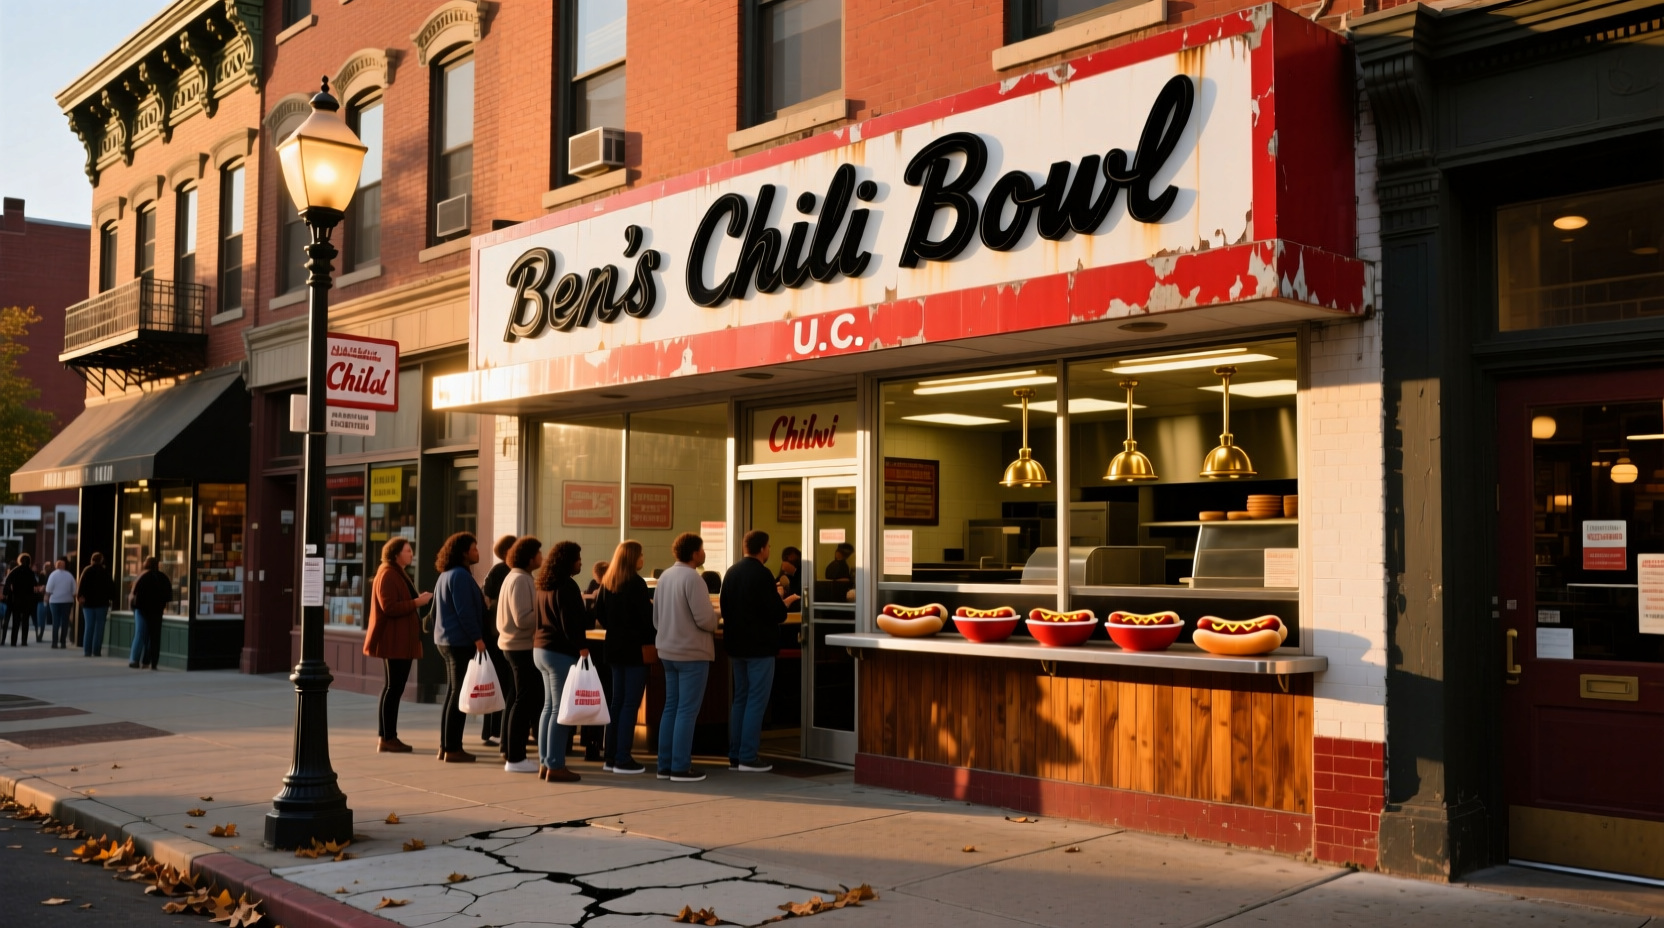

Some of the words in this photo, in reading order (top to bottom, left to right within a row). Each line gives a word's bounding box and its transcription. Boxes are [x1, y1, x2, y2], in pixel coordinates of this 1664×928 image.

[504, 225, 661, 343] Ben's
[686, 163, 878, 308] Chili
[899, 74, 1194, 268] Bowl
[794, 313, 863, 354] U.C.
